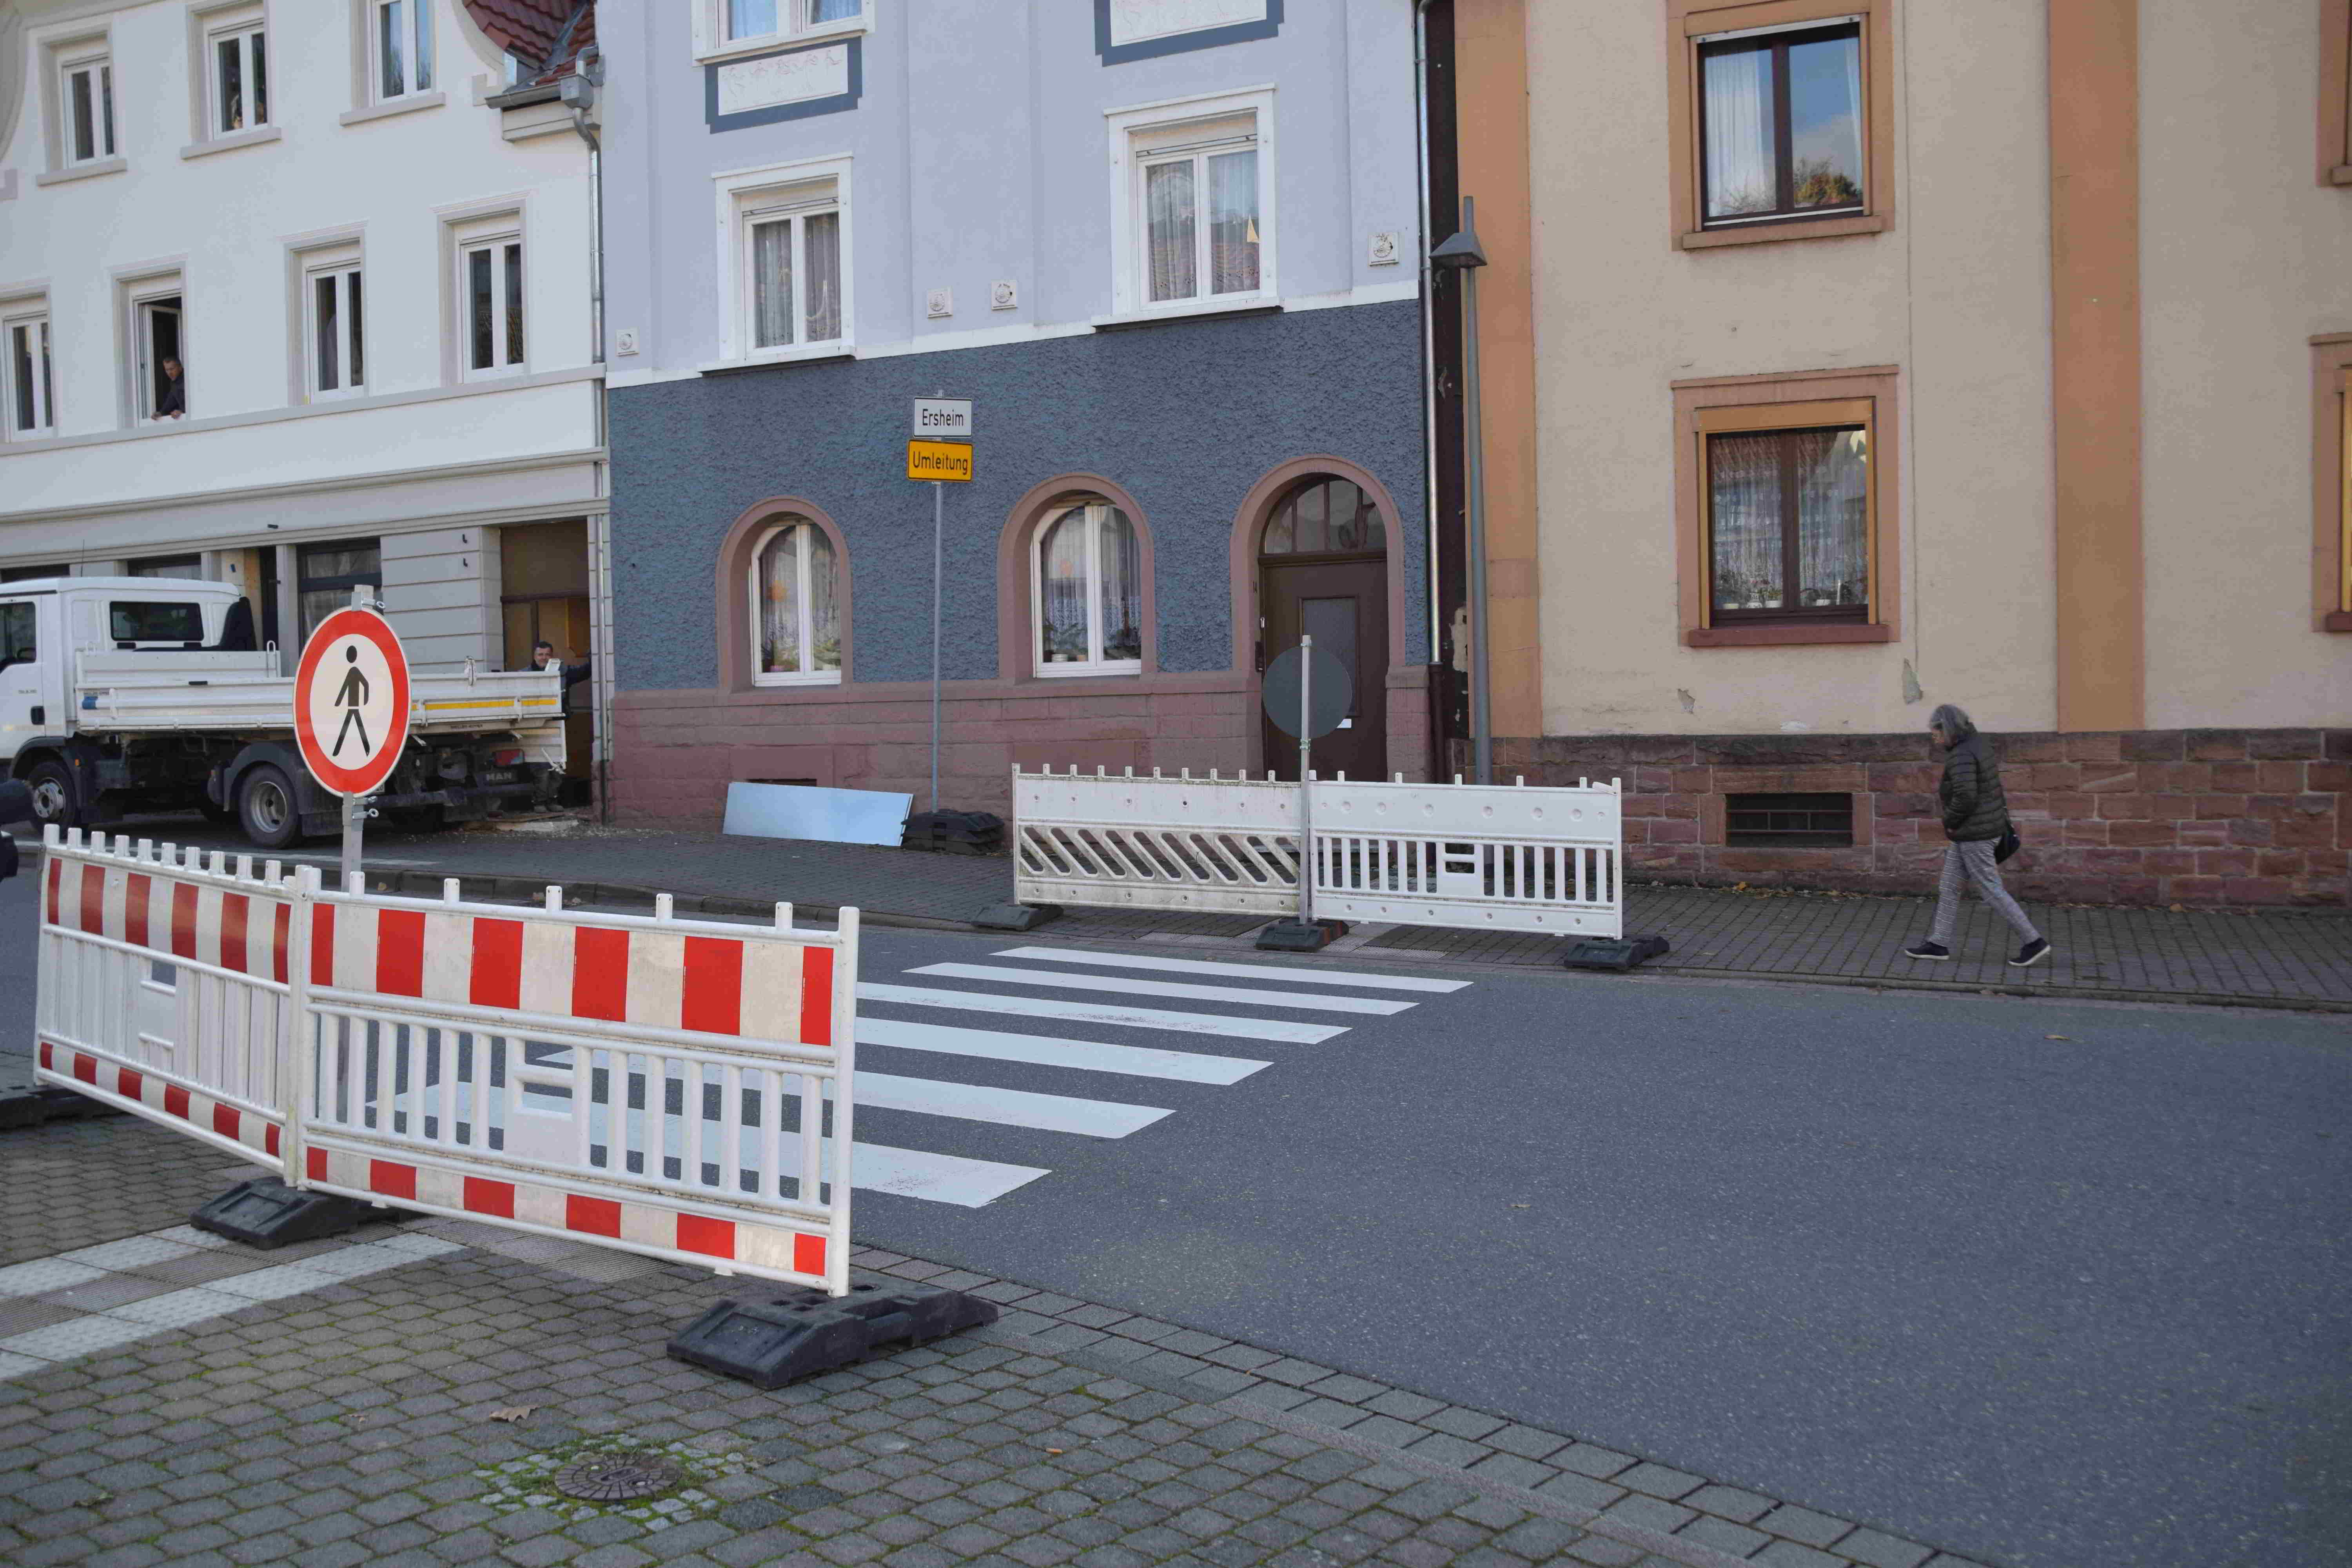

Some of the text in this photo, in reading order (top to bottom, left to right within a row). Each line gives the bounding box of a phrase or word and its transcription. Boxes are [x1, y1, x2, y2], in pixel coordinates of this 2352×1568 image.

[922, 408, 964, 426] Ersheim
[913, 451, 968, 475] Umleitung
[486, 772, 512, 781] MAN
